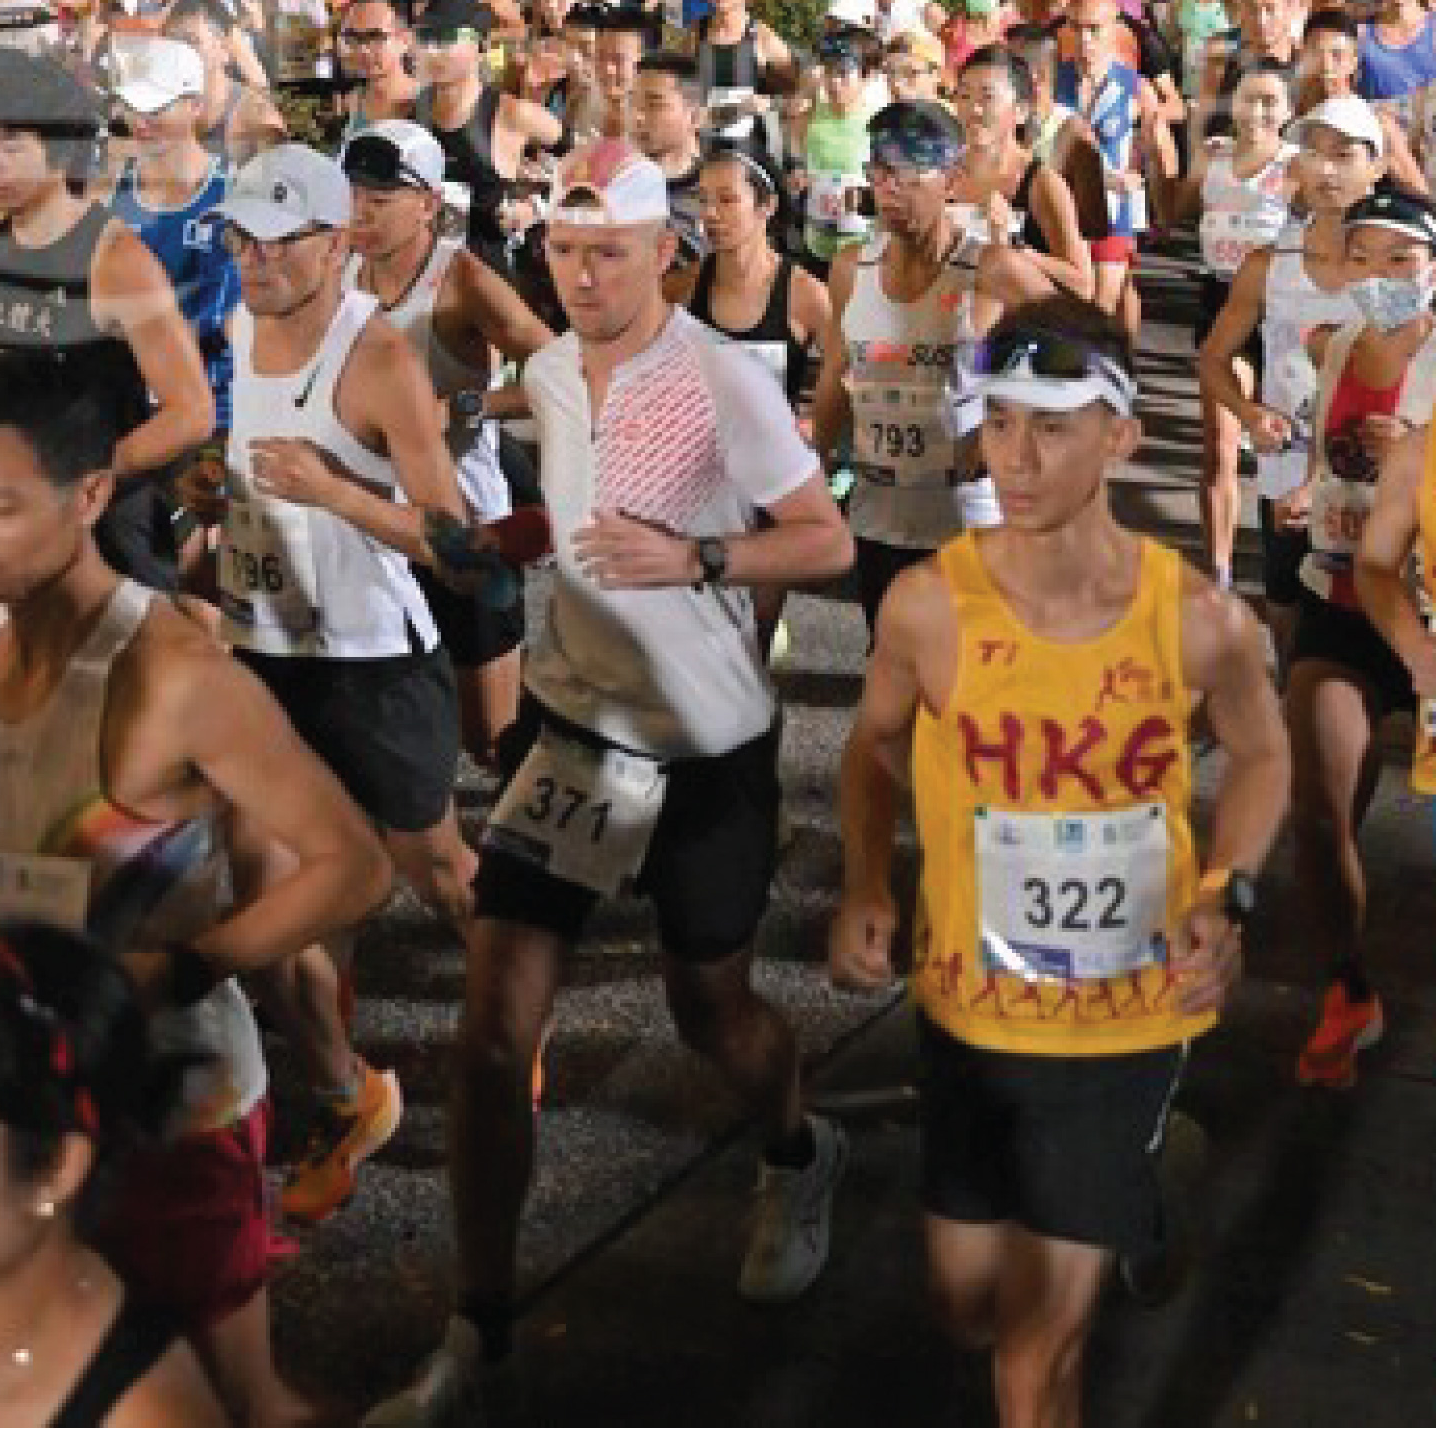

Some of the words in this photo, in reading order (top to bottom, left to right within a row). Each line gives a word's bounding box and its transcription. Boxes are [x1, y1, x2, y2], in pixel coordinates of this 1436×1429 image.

[869, 423, 926, 458] 793
[957, 711, 1179, 801] HKG
[524, 776, 612, 845] 371
[1023, 876, 1129, 932] 322
